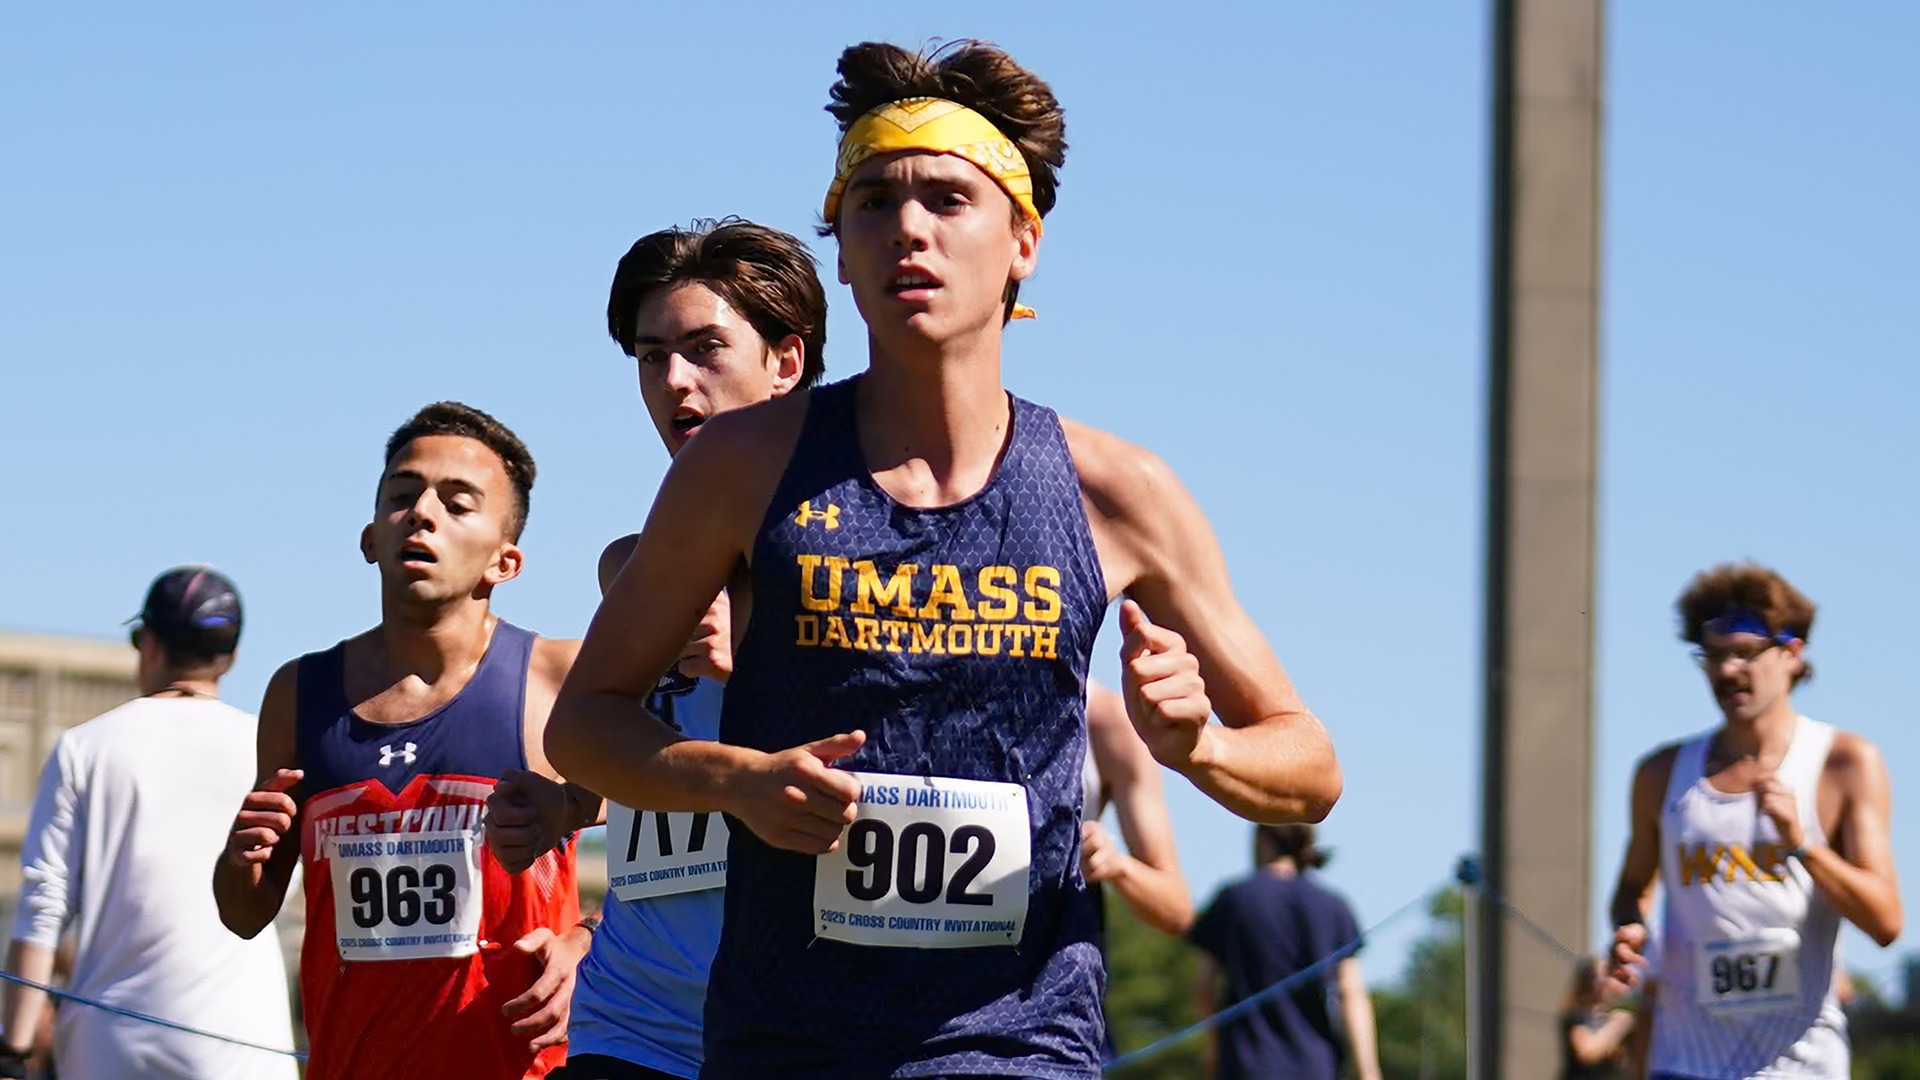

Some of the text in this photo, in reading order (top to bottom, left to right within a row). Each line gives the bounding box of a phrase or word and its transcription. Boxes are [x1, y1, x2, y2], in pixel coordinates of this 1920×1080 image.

[797, 554, 1062, 622] UMASS
[795, 615, 1060, 659] DARTMOUTH
[338, 838, 465, 857] UMASS DARTMOUTH
[845, 818, 996, 906] 902
[649, 866, 685, 881] COUNTRY
[350, 863, 456, 929] 963
[384, 935, 420, 947] COUNTRY
[820, 909, 1015, 933] 2025 CROSS COUNTRY INVITATIONAL
[1712, 953, 1781, 994] 967
